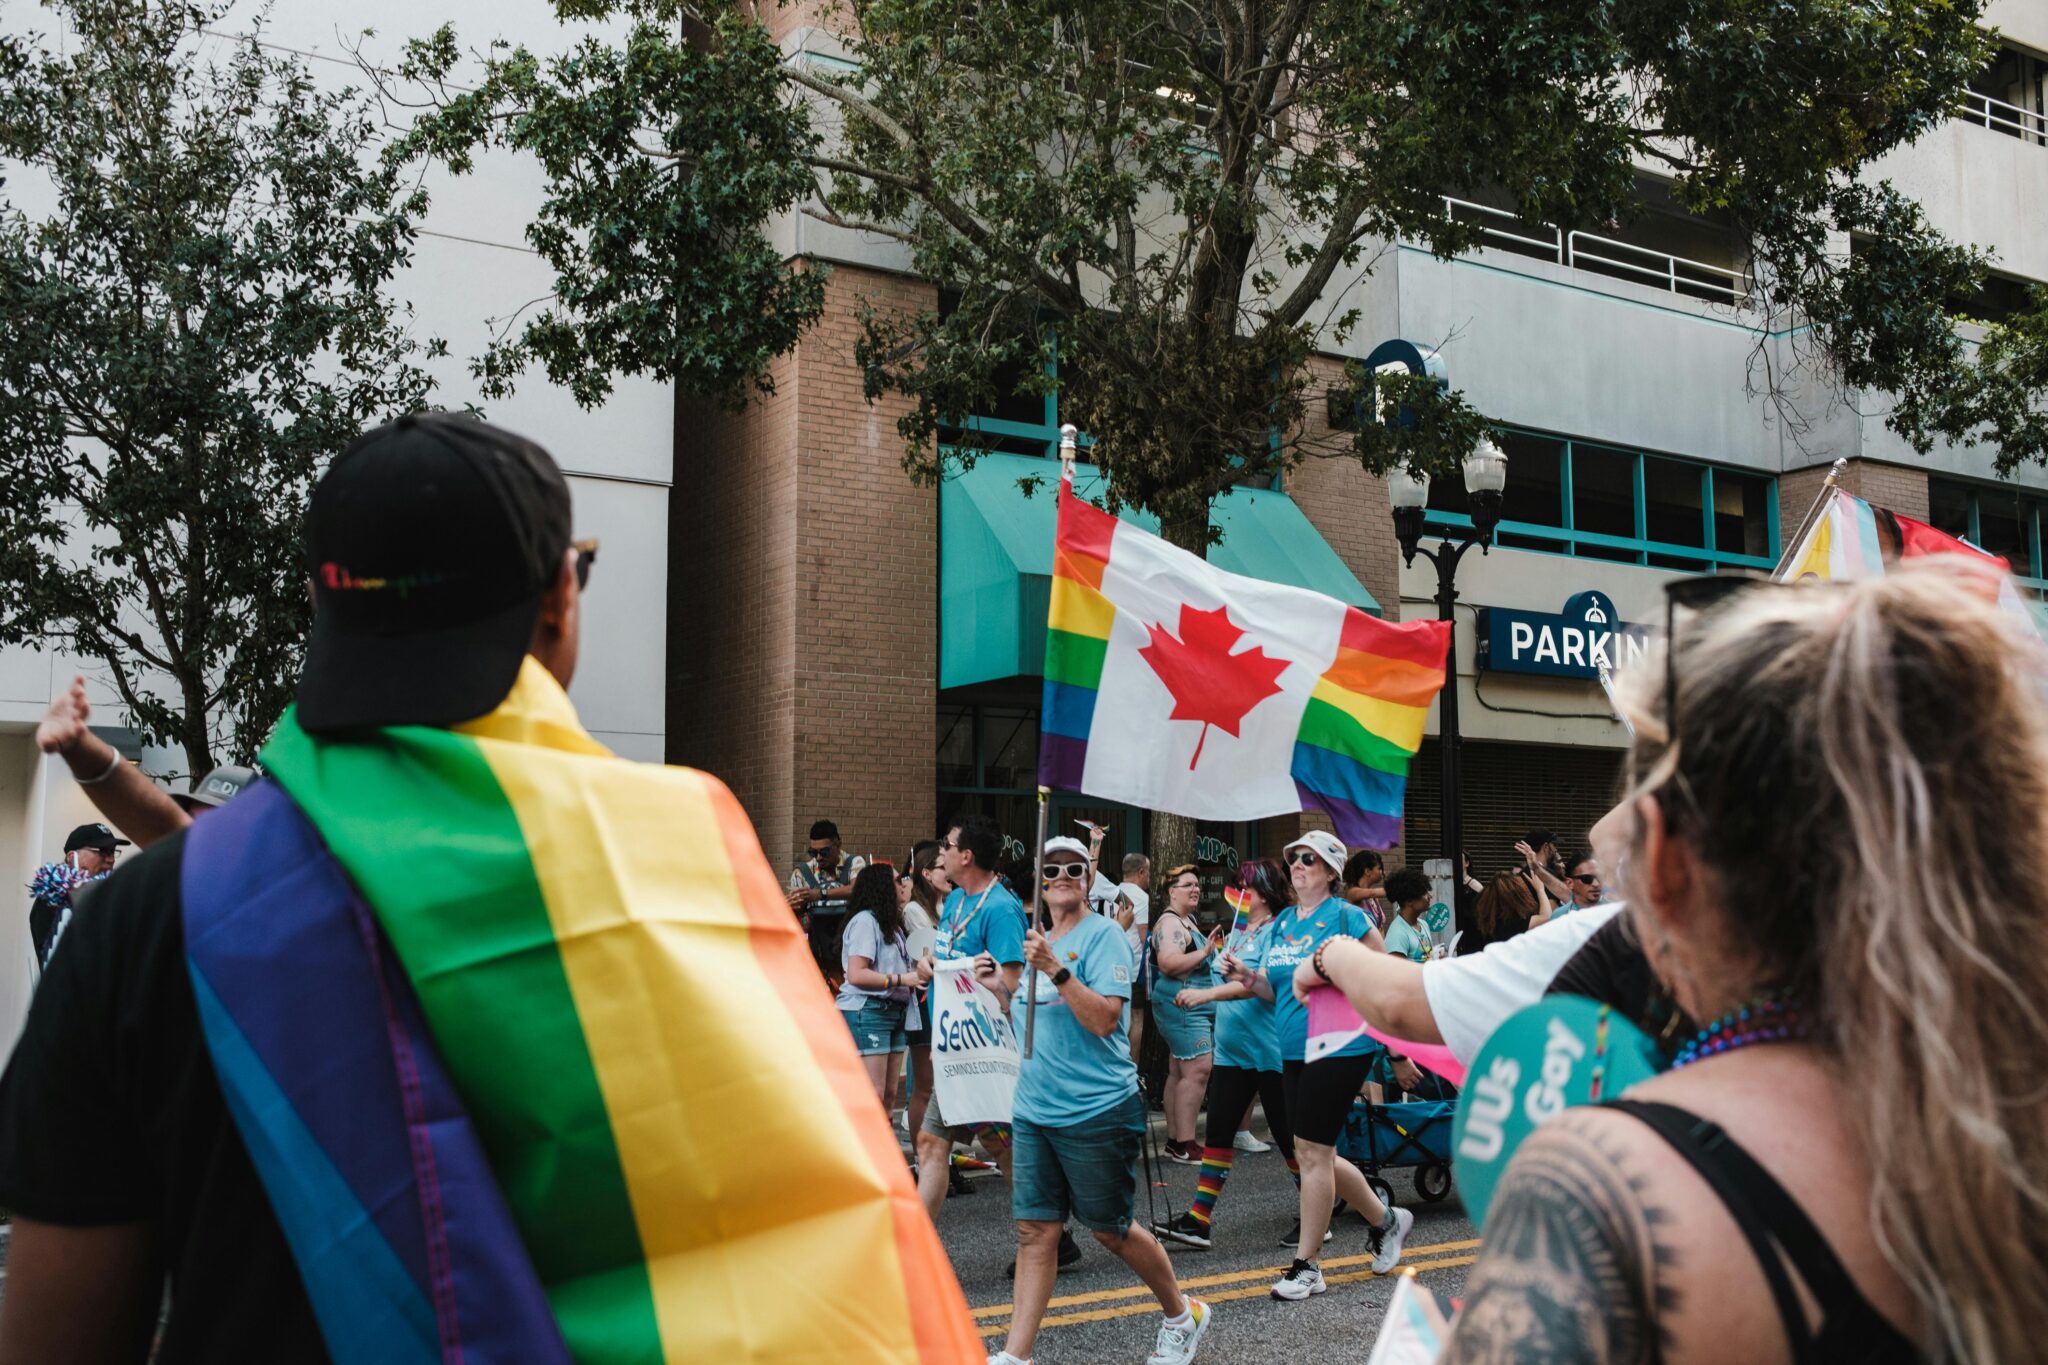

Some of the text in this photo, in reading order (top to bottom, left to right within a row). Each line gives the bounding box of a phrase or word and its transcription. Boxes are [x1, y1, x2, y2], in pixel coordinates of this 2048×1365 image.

[1511, 621, 1650, 671] PARKIN
[943, 1062, 979, 1078] SEMINOLE
[1524, 1017, 1586, 1124] Gay
